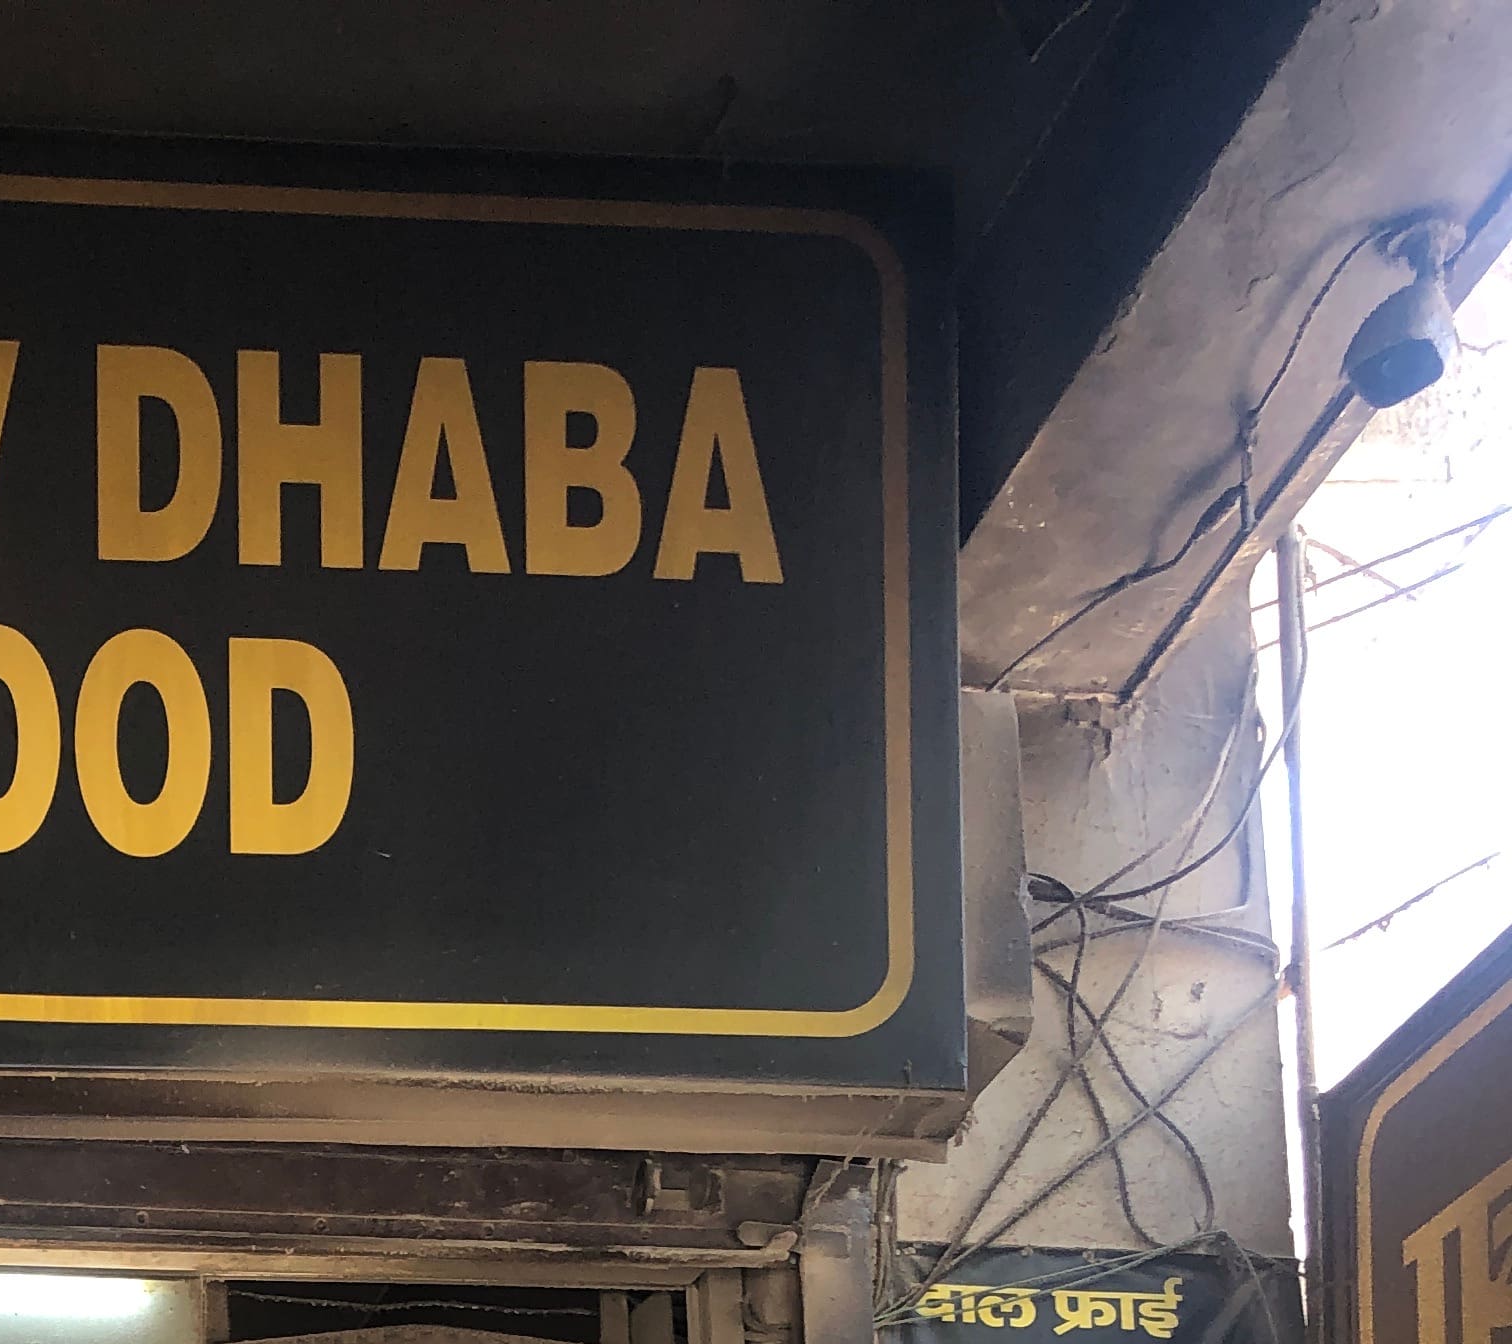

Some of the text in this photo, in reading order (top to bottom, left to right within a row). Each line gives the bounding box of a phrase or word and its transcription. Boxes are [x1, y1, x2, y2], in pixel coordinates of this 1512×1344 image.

[96, 343, 784, 585] DHABA
[915, 1277, 1183, 1338] दाल फ्राई
